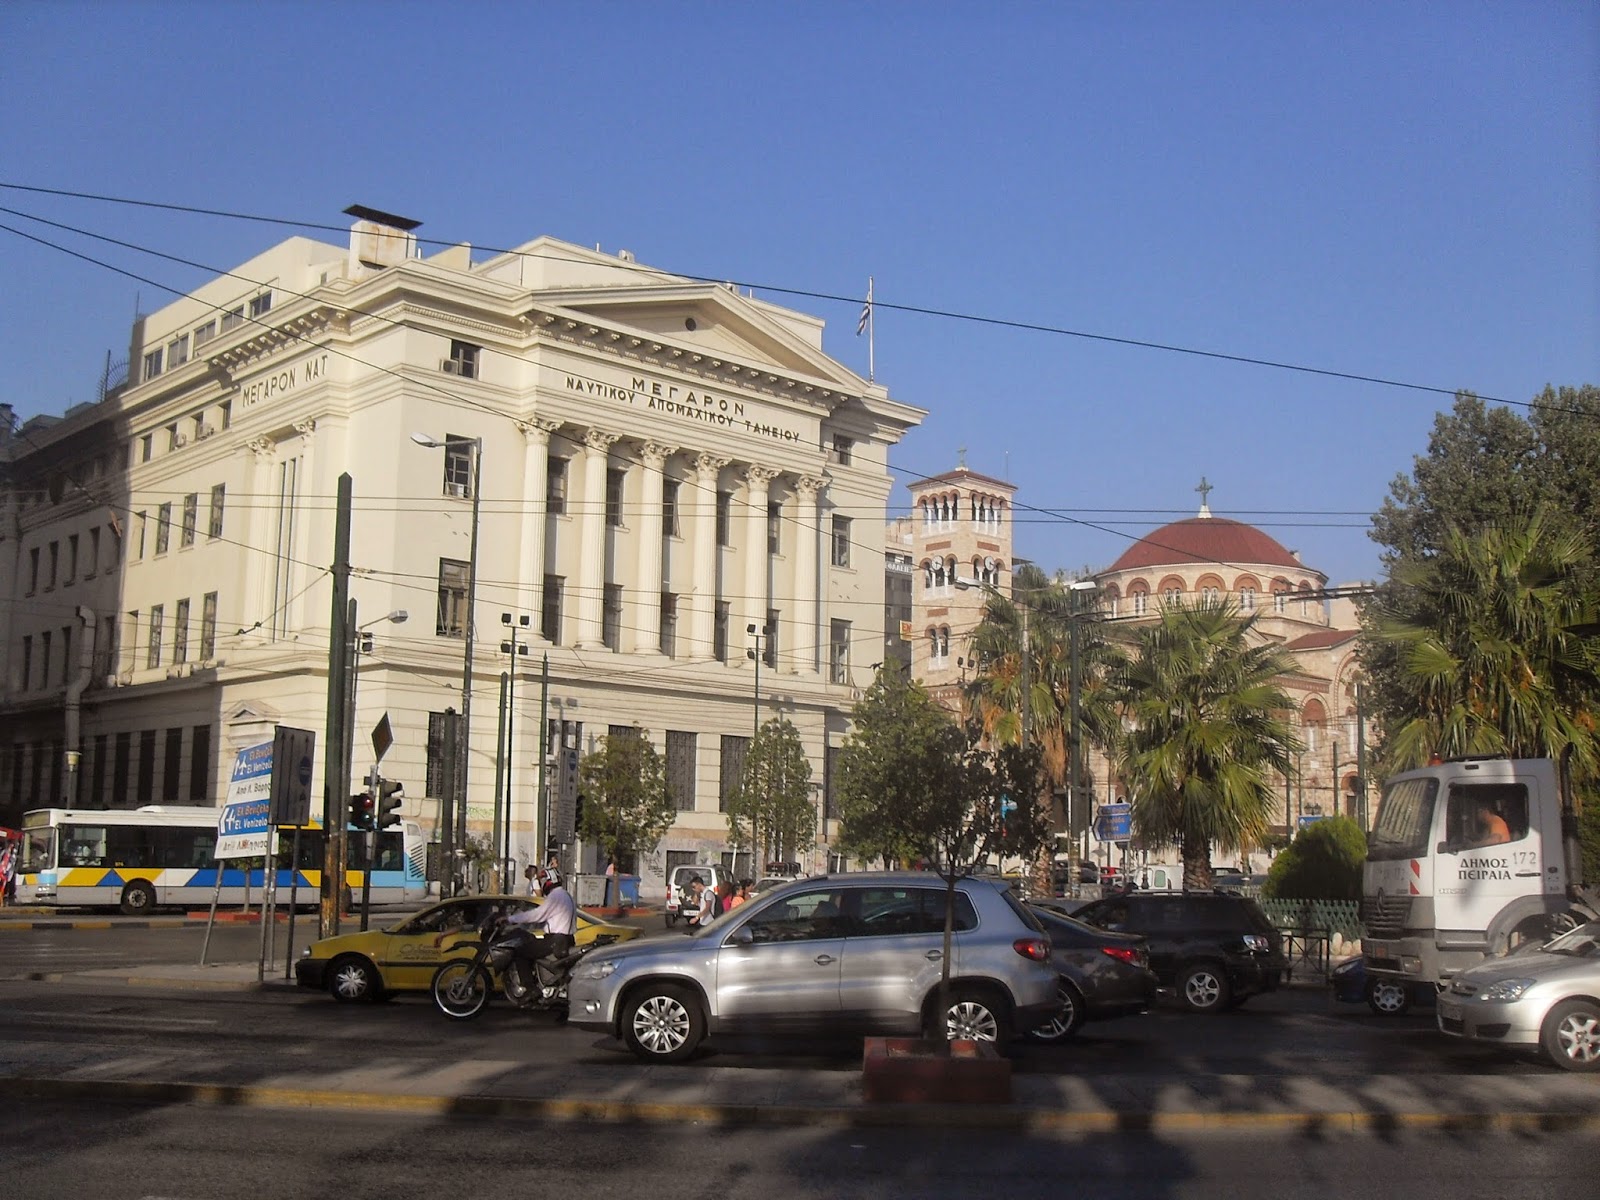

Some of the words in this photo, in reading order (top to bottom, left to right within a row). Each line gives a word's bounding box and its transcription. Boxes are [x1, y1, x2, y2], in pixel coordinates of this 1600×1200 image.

[242, 368, 296, 407] ΜΕΓΑΡΟΝ
[305, 355, 328, 382] ΝΑΤ
[632, 377, 745, 416] ΜΕΓΑΡΟΝ
[566, 376, 635, 403] ΝΑΥΤΙΚΟΥ
[648, 397, 734, 427] ΑΠΟΜΑΧΙΚΟΥ
[745, 421, 800, 442] ΤΑΜΕΙΟΥ
[243, 816, 268, 828] Venizelo
[1460, 858, 1508, 868] ΔΗΜΟΣ
[1512, 851, 1537, 865] 172
[1458, 870, 1511, 880] ΠΕΙΡΑΙΑ
